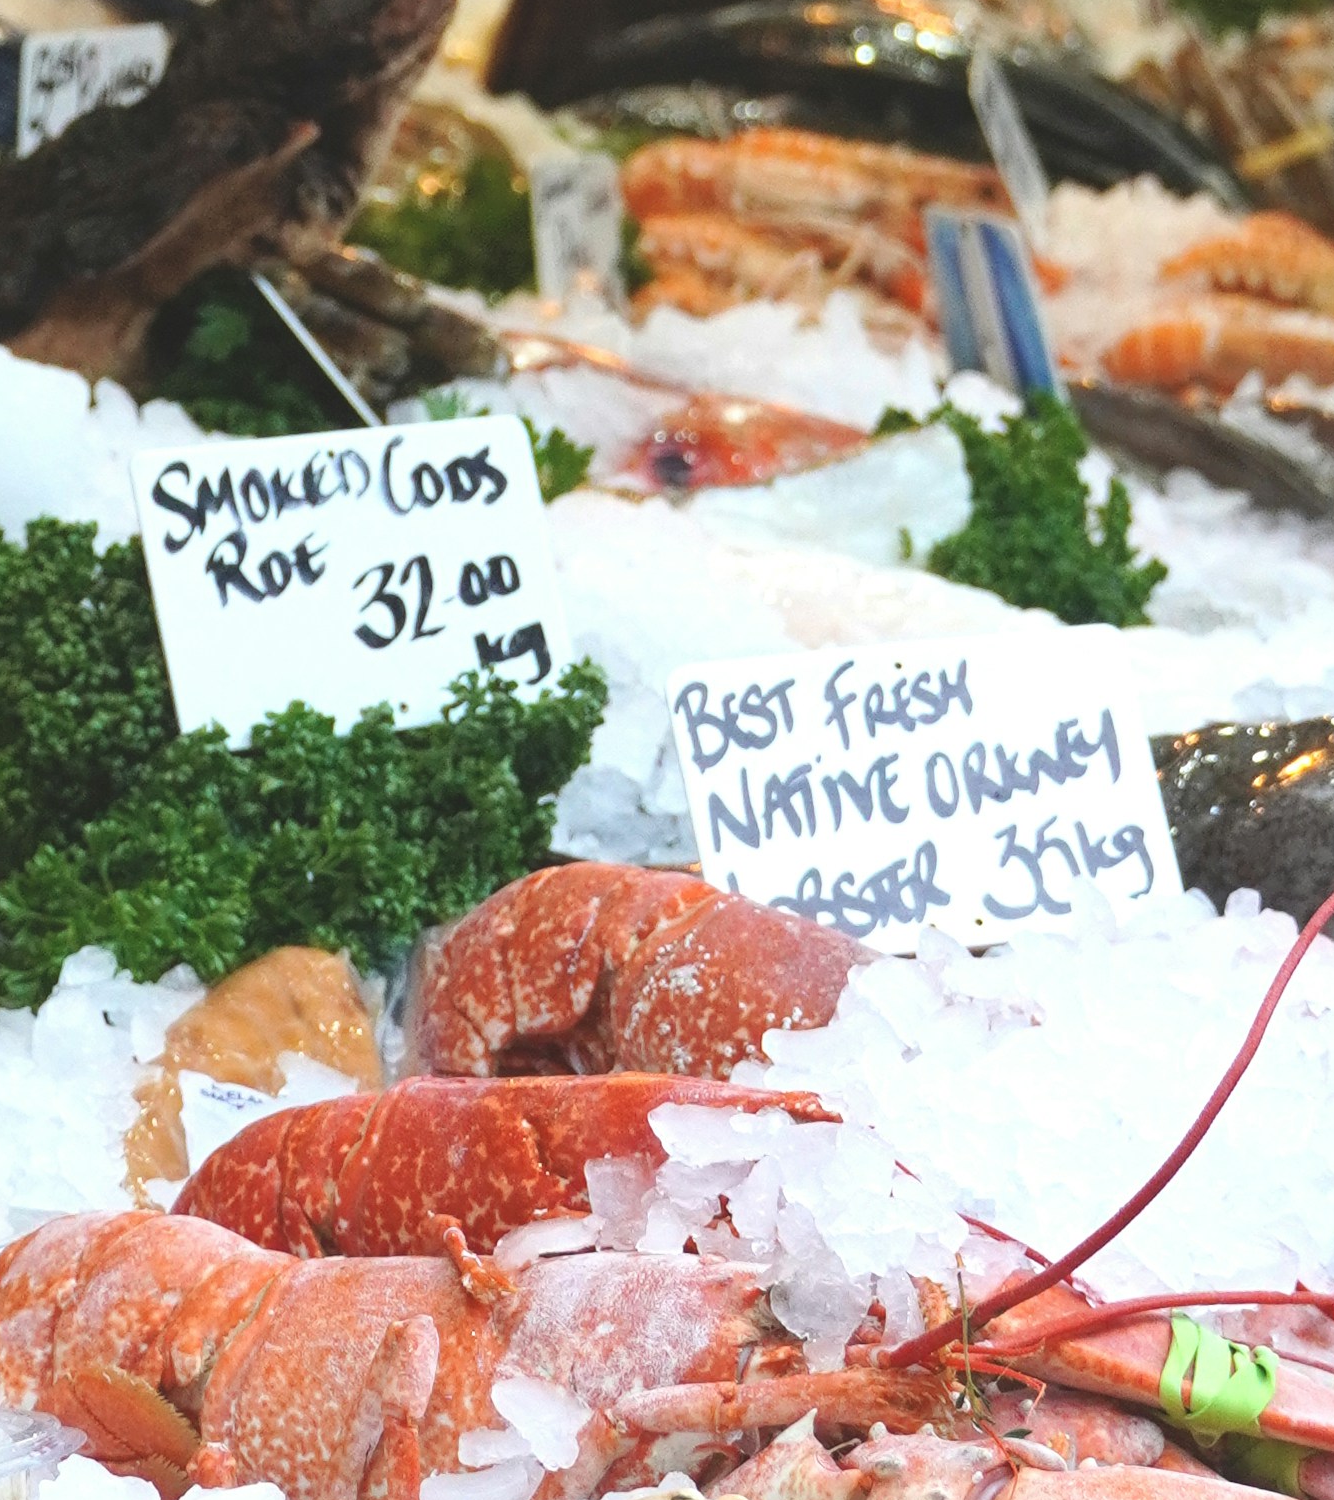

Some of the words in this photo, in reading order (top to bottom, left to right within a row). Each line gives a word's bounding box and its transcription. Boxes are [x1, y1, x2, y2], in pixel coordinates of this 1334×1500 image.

[151, 458, 371, 555] SMOKED
[381, 434, 508, 517] CODS
[204, 529, 330, 608] ROE
[673, 681, 796, 774] BEST
[823, 659, 973, 751] FRESH
[707, 752, 911, 853] NATIVE
[924, 707, 1122, 816] ORKNEY
